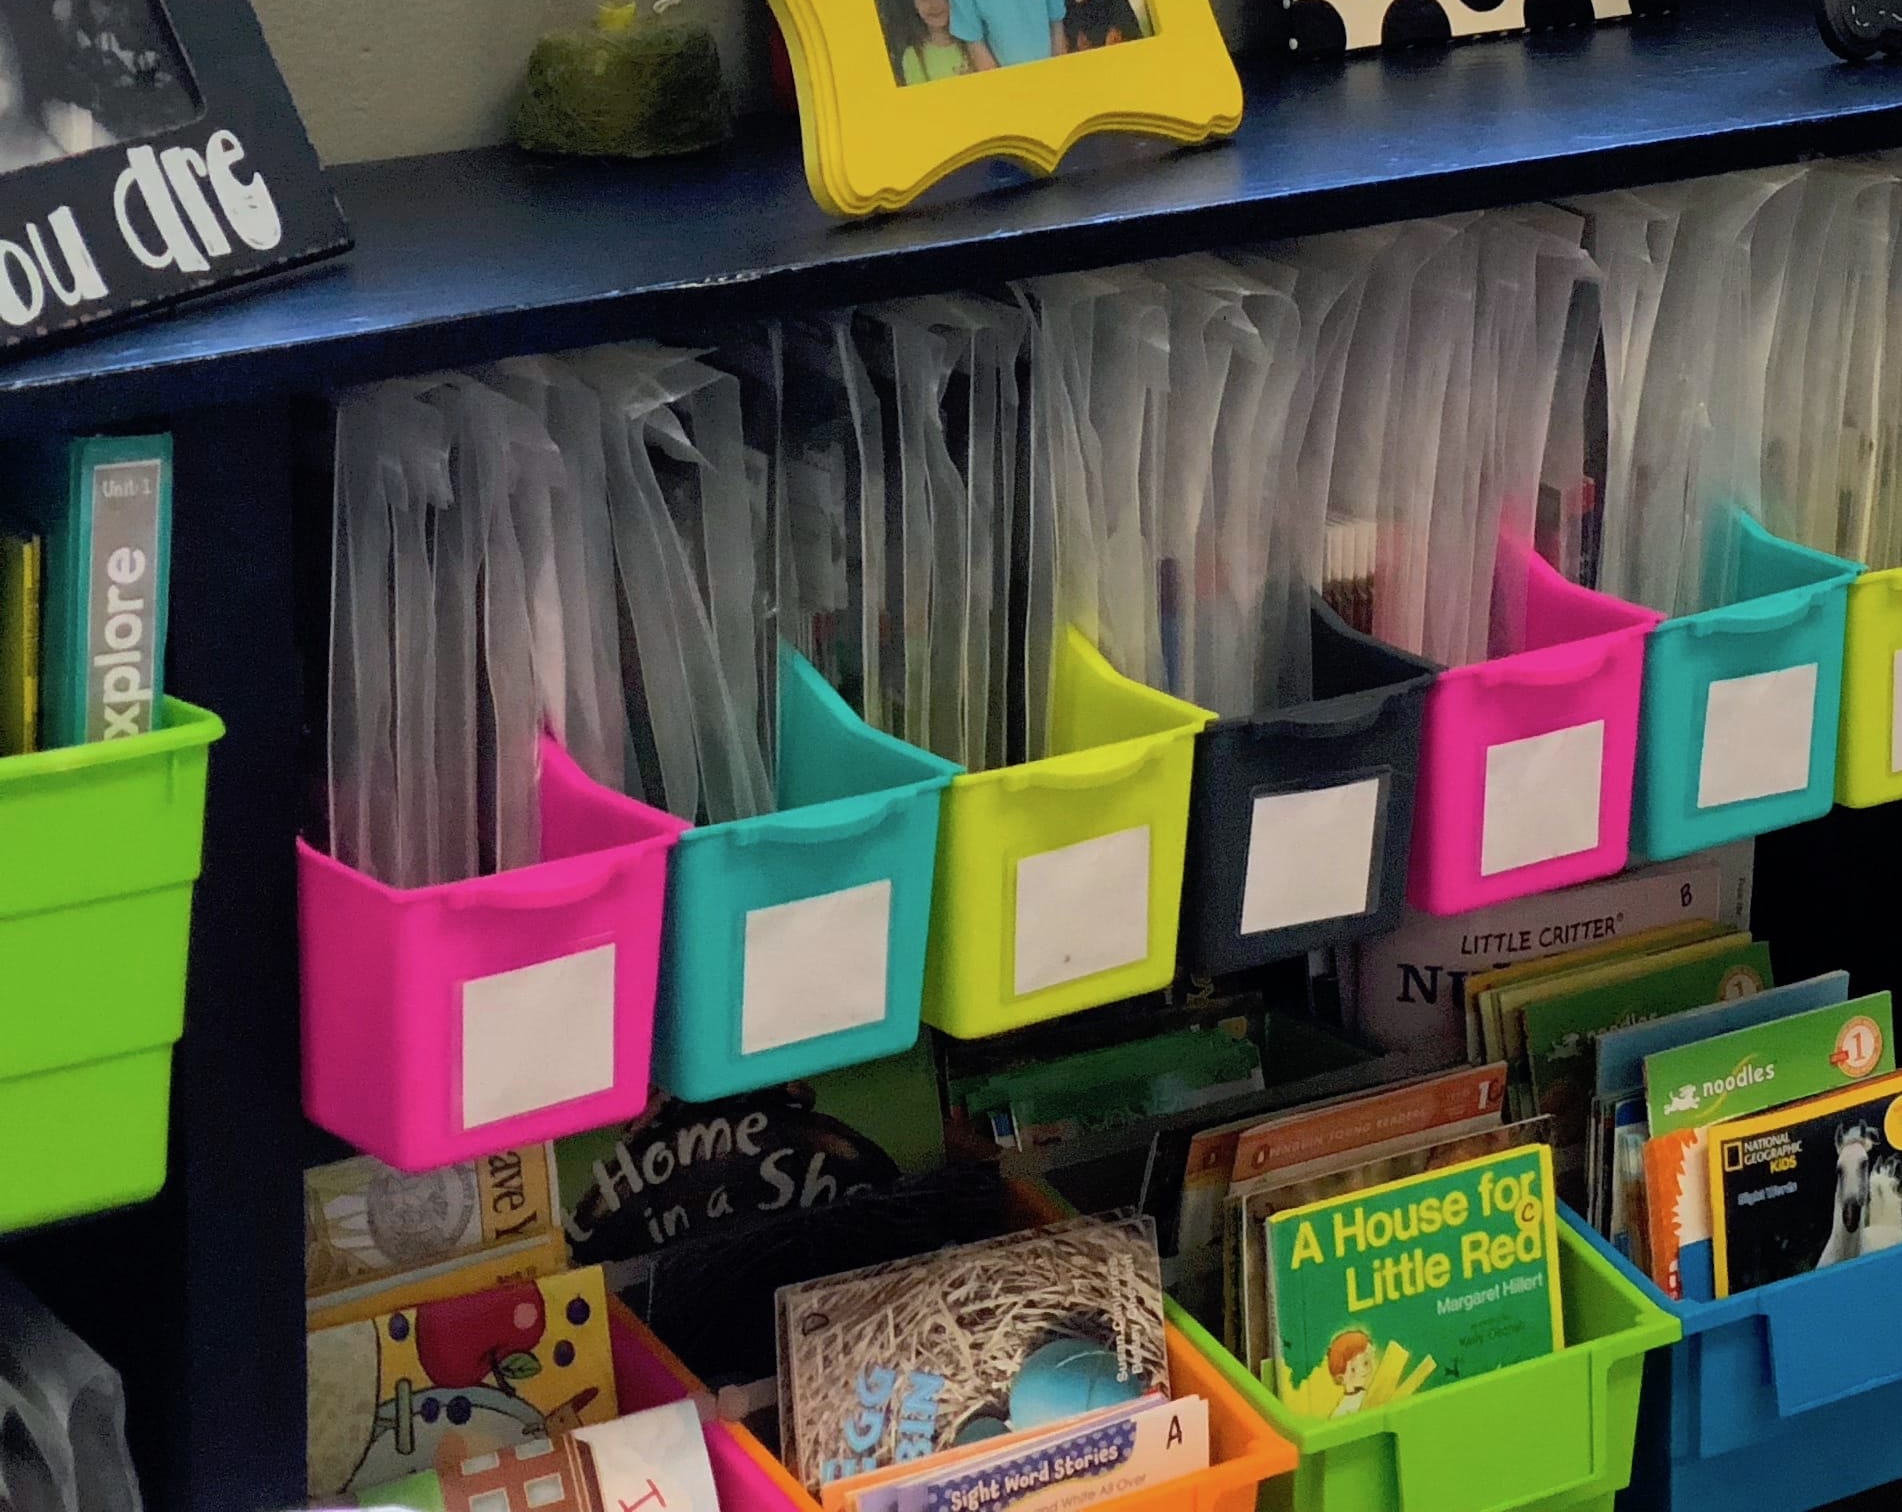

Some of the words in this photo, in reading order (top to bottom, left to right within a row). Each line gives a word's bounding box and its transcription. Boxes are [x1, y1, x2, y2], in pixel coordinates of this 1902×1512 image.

[0, 204, 108, 326] ou
[94, 546, 151, 741] xplore
[1680, 882, 1693, 908] B
[1461, 925, 1532, 955] LITTLE
[1851, 1032, 1865, 1061] 1
[1702, 1062, 1776, 1099] noodles
[593, 1111, 768, 1213] Home
[1744, 1132, 1790, 1152] NATIONAL
[1744, 1140, 1803, 1166] GEOGRAPHIC
[487, 1150, 525, 1214] ave
[643, 1203, 690, 1245] in
[706, 1186, 734, 1219] a
[1291, 1221, 1325, 1270] A
[1333, 1190, 1469, 1258] House
[1478, 1170, 1536, 1217] for
[1346, 1248, 1451, 1313] Little
[1461, 1228, 1543, 1280] Red
[1436, 1284, 1501, 1316] Margaret
[1503, 1272, 1544, 1298] Hillert
[896, 1371, 948, 1464] BIN
[1165, 1414, 1183, 1450] A
[949, 1478, 1002, 1512] Sight
[1004, 1459, 1051, 1494] Word
[1054, 1444, 1119, 1479] Stories
